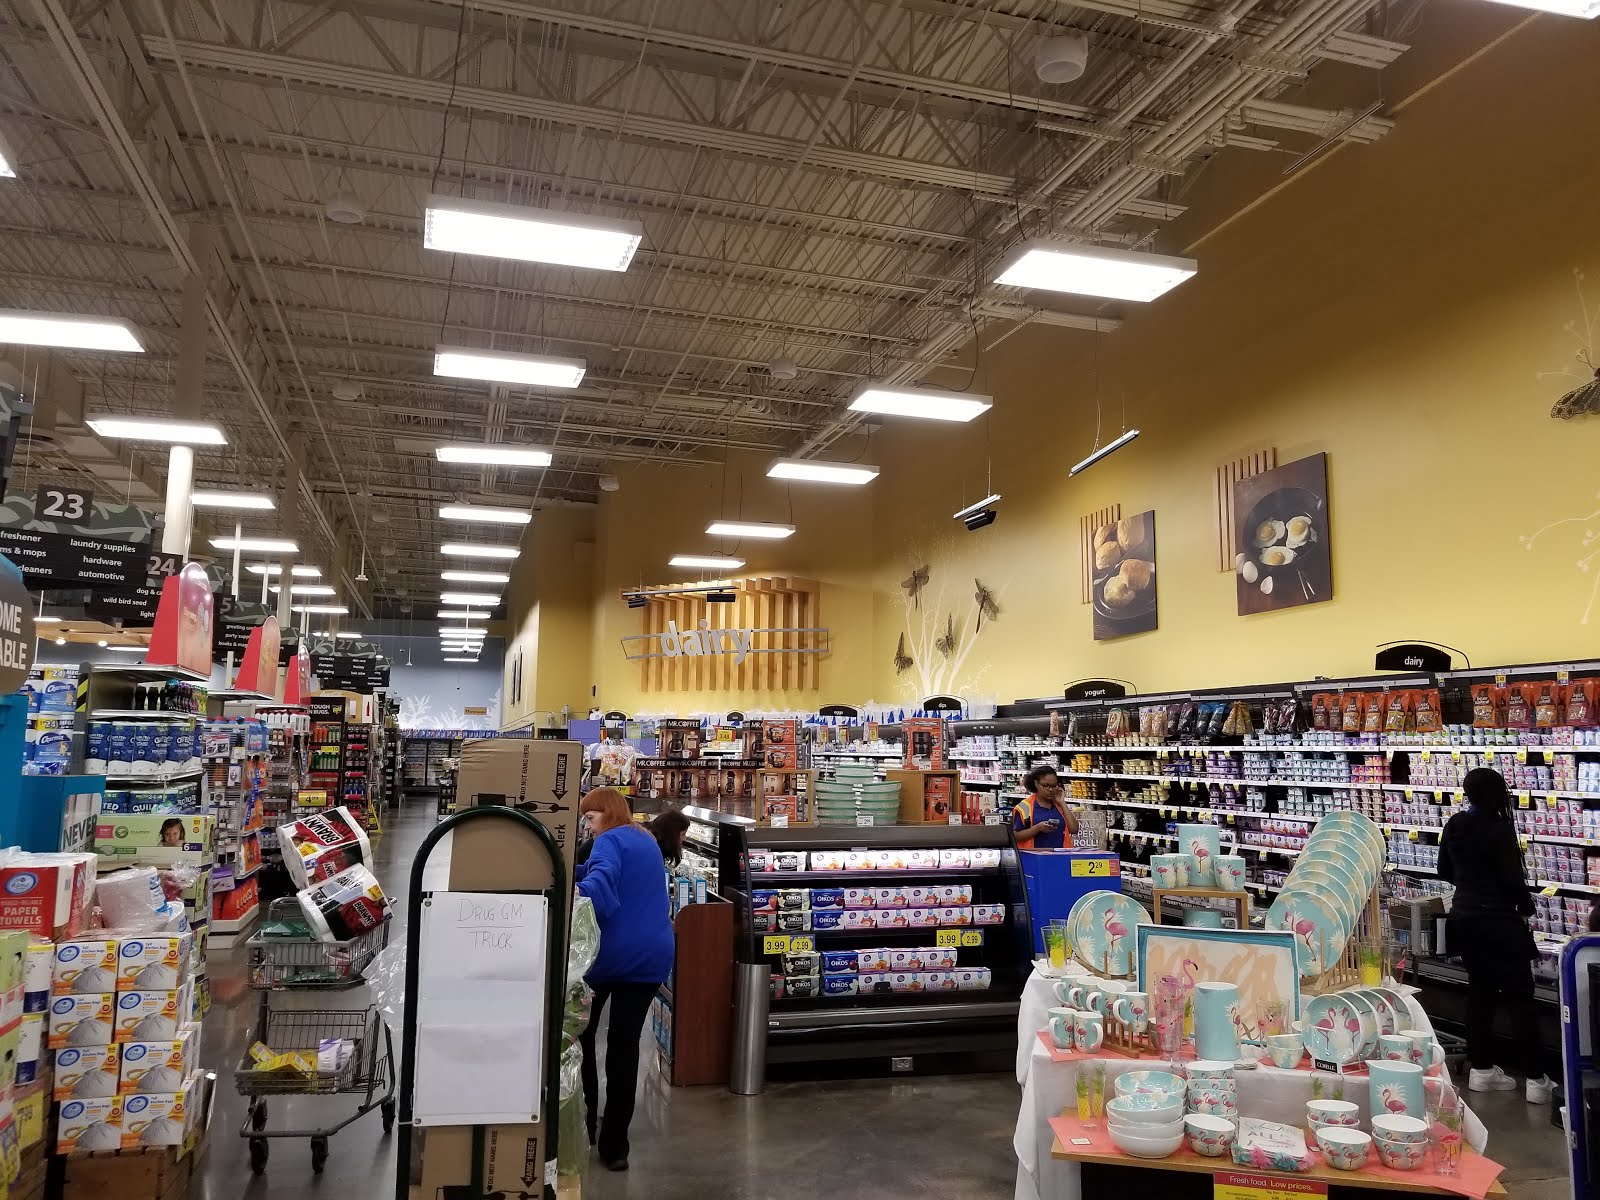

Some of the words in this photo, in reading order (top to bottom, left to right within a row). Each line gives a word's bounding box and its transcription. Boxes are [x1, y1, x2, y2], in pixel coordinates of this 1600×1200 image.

[43, 491, 84, 519] 23
[0, 530, 41, 543] freshener
[70, 539, 101, 550] laundry
[103, 543, 136, 553] supplies
[23, 549, 47, 558] mops
[83, 555, 122, 567] hardware
[147, 555, 175, 577] 24
[78, 570, 125, 581] automotive
[219, 597, 232, 613] 5
[338, 639, 353, 650] 27
[660, 618, 752, 665] dairy
[1404, 656, 1424, 668] dairy
[1084, 689, 1106, 697] yogurt
[520, 787, 526, 795] DO
[556, 776, 564, 794] HANG
[63, 814, 98, 849] NEVER
[4, 906, 38, 915] PAPER
[354, 901, 376, 925] BRAWNY
[457, 898, 495, 921] DRUG
[501, 902, 523, 920] GM
[0, 916, 42, 925] TOWELS
[468, 931, 513, 949] TRUCK
[766, 941, 785, 950] 3.99
[939, 935, 956, 944] 3.99
[527, 1140, 535, 1159] HERE
[525, 1162, 534, 1181] HANG
[1229, 1175, 1249, 1184] Fresh
[1250, 1178, 1268, 1186] food.
[1270, 1180, 1286, 1188] Low
[1288, 1183, 1313, 1191] prices.
